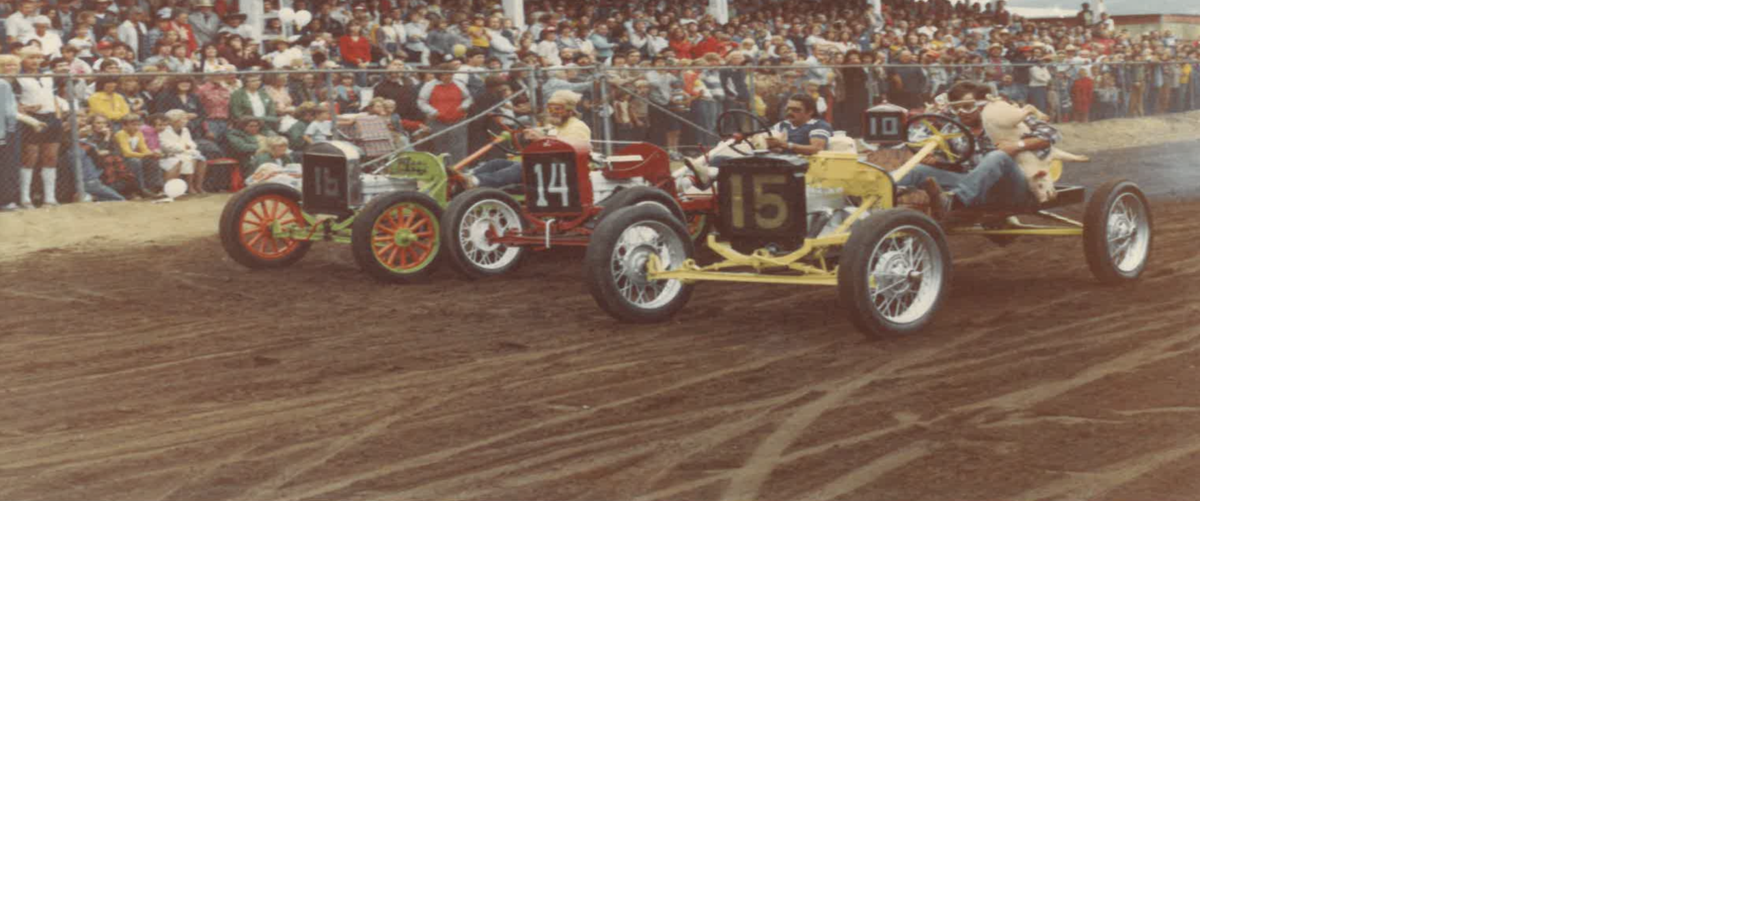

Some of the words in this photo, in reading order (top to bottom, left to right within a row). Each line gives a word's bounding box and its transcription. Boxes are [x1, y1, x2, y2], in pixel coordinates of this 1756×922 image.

[869, 116, 898, 135] 10
[534, 162, 569, 207] 14
[729, 174, 788, 229] 15
